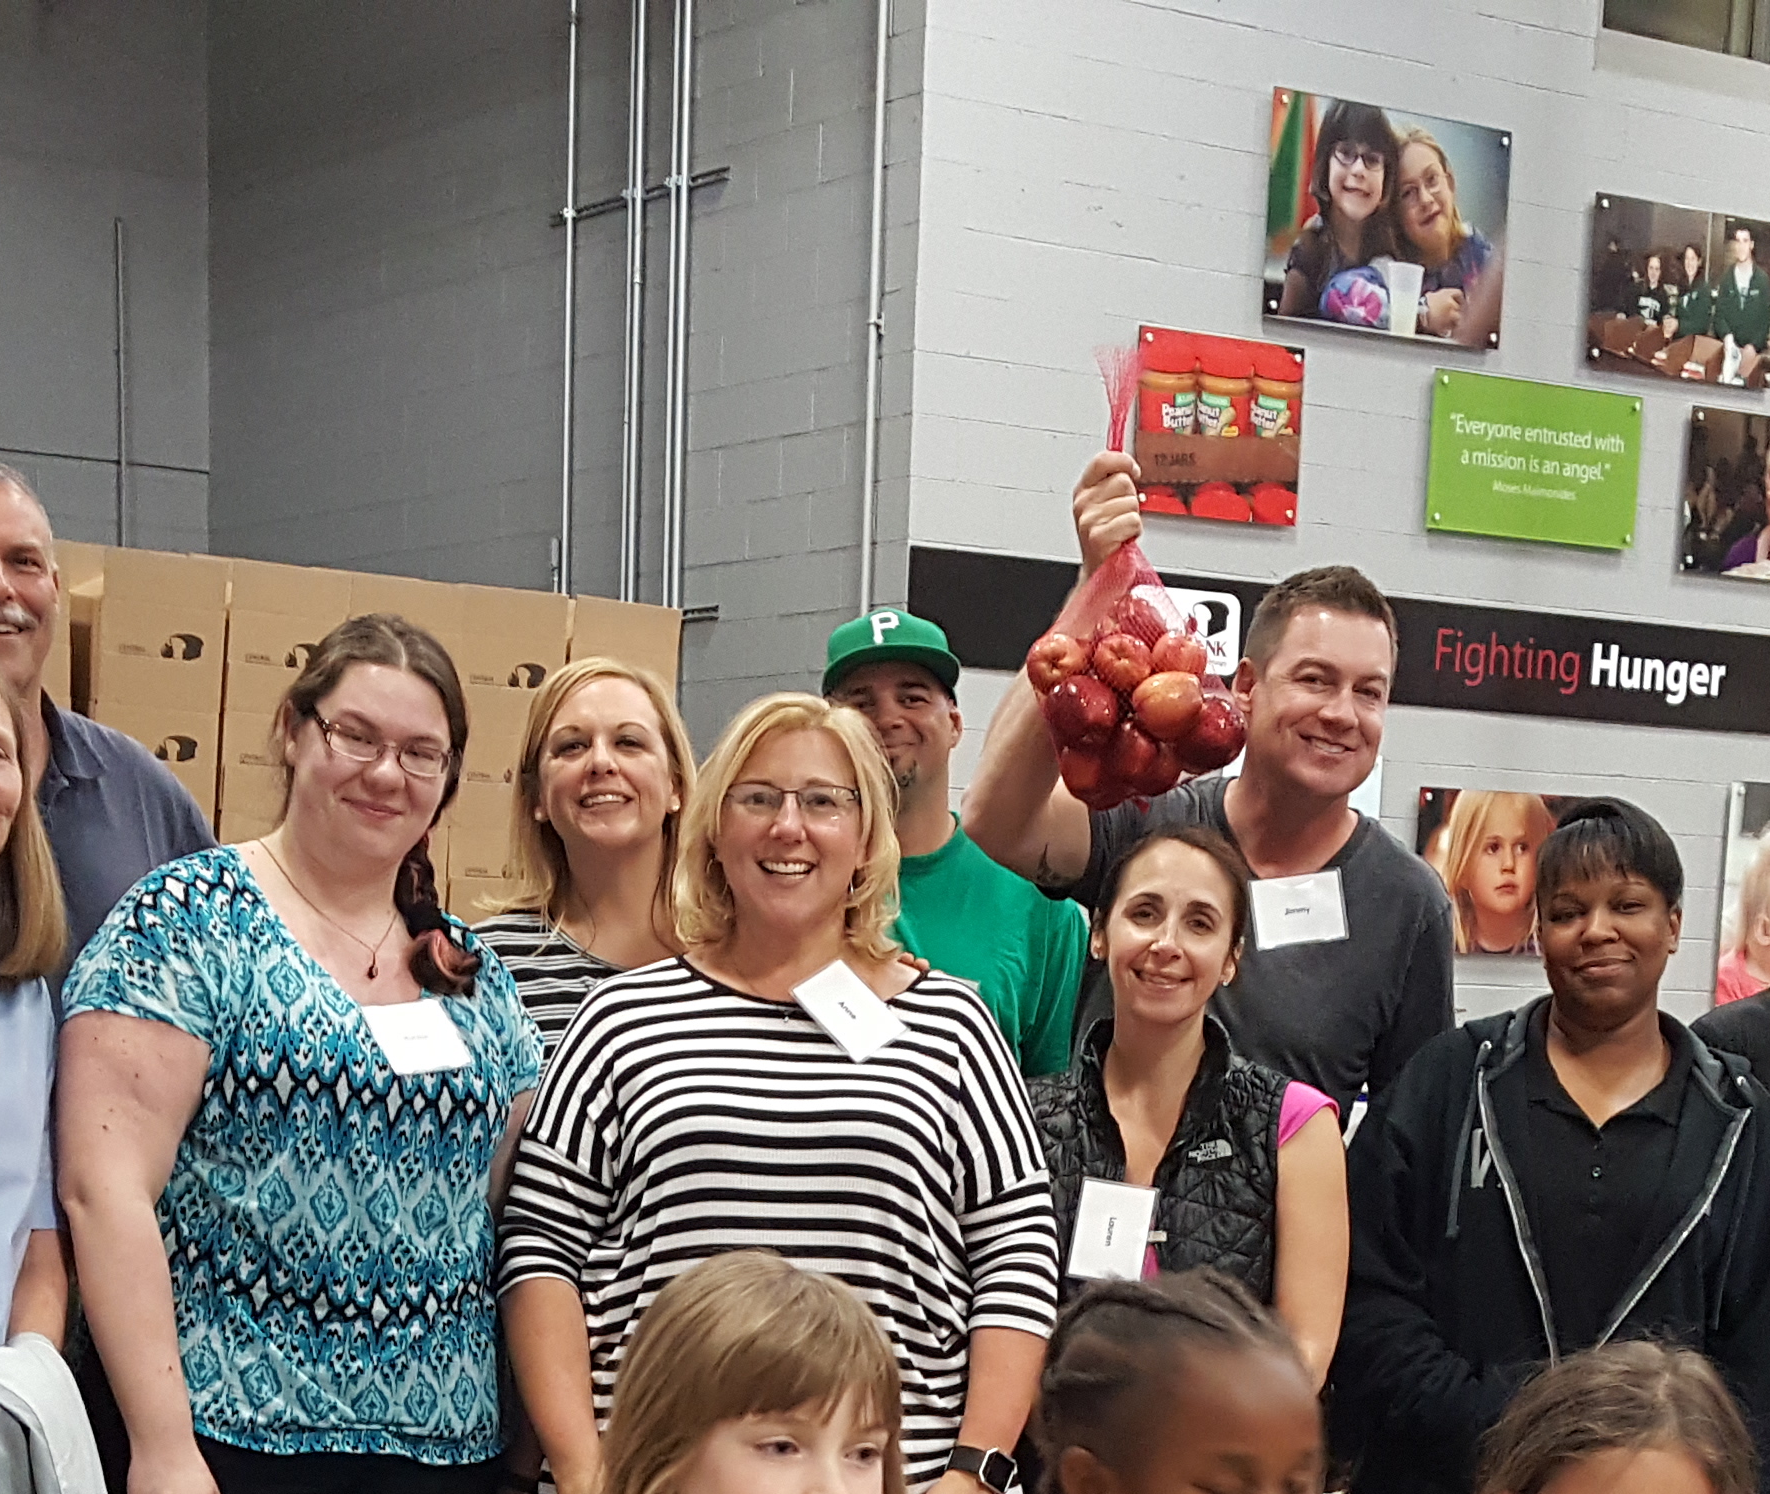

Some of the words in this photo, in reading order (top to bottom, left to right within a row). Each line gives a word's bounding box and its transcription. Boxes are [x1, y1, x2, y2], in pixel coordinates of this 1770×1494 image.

[1524, 424, 1592, 450] entrusted
[1594, 432, 1626, 454] with
[1460, 449, 1470, 465] a
[1472, 449, 1526, 472] mission
[1529, 454, 1540, 474] is
[1542, 458, 1561, 476] an
[870, 611, 900, 644] P
[1434, 627, 1581, 695] Fighting
[1590, 642, 1727, 705] Hunger
